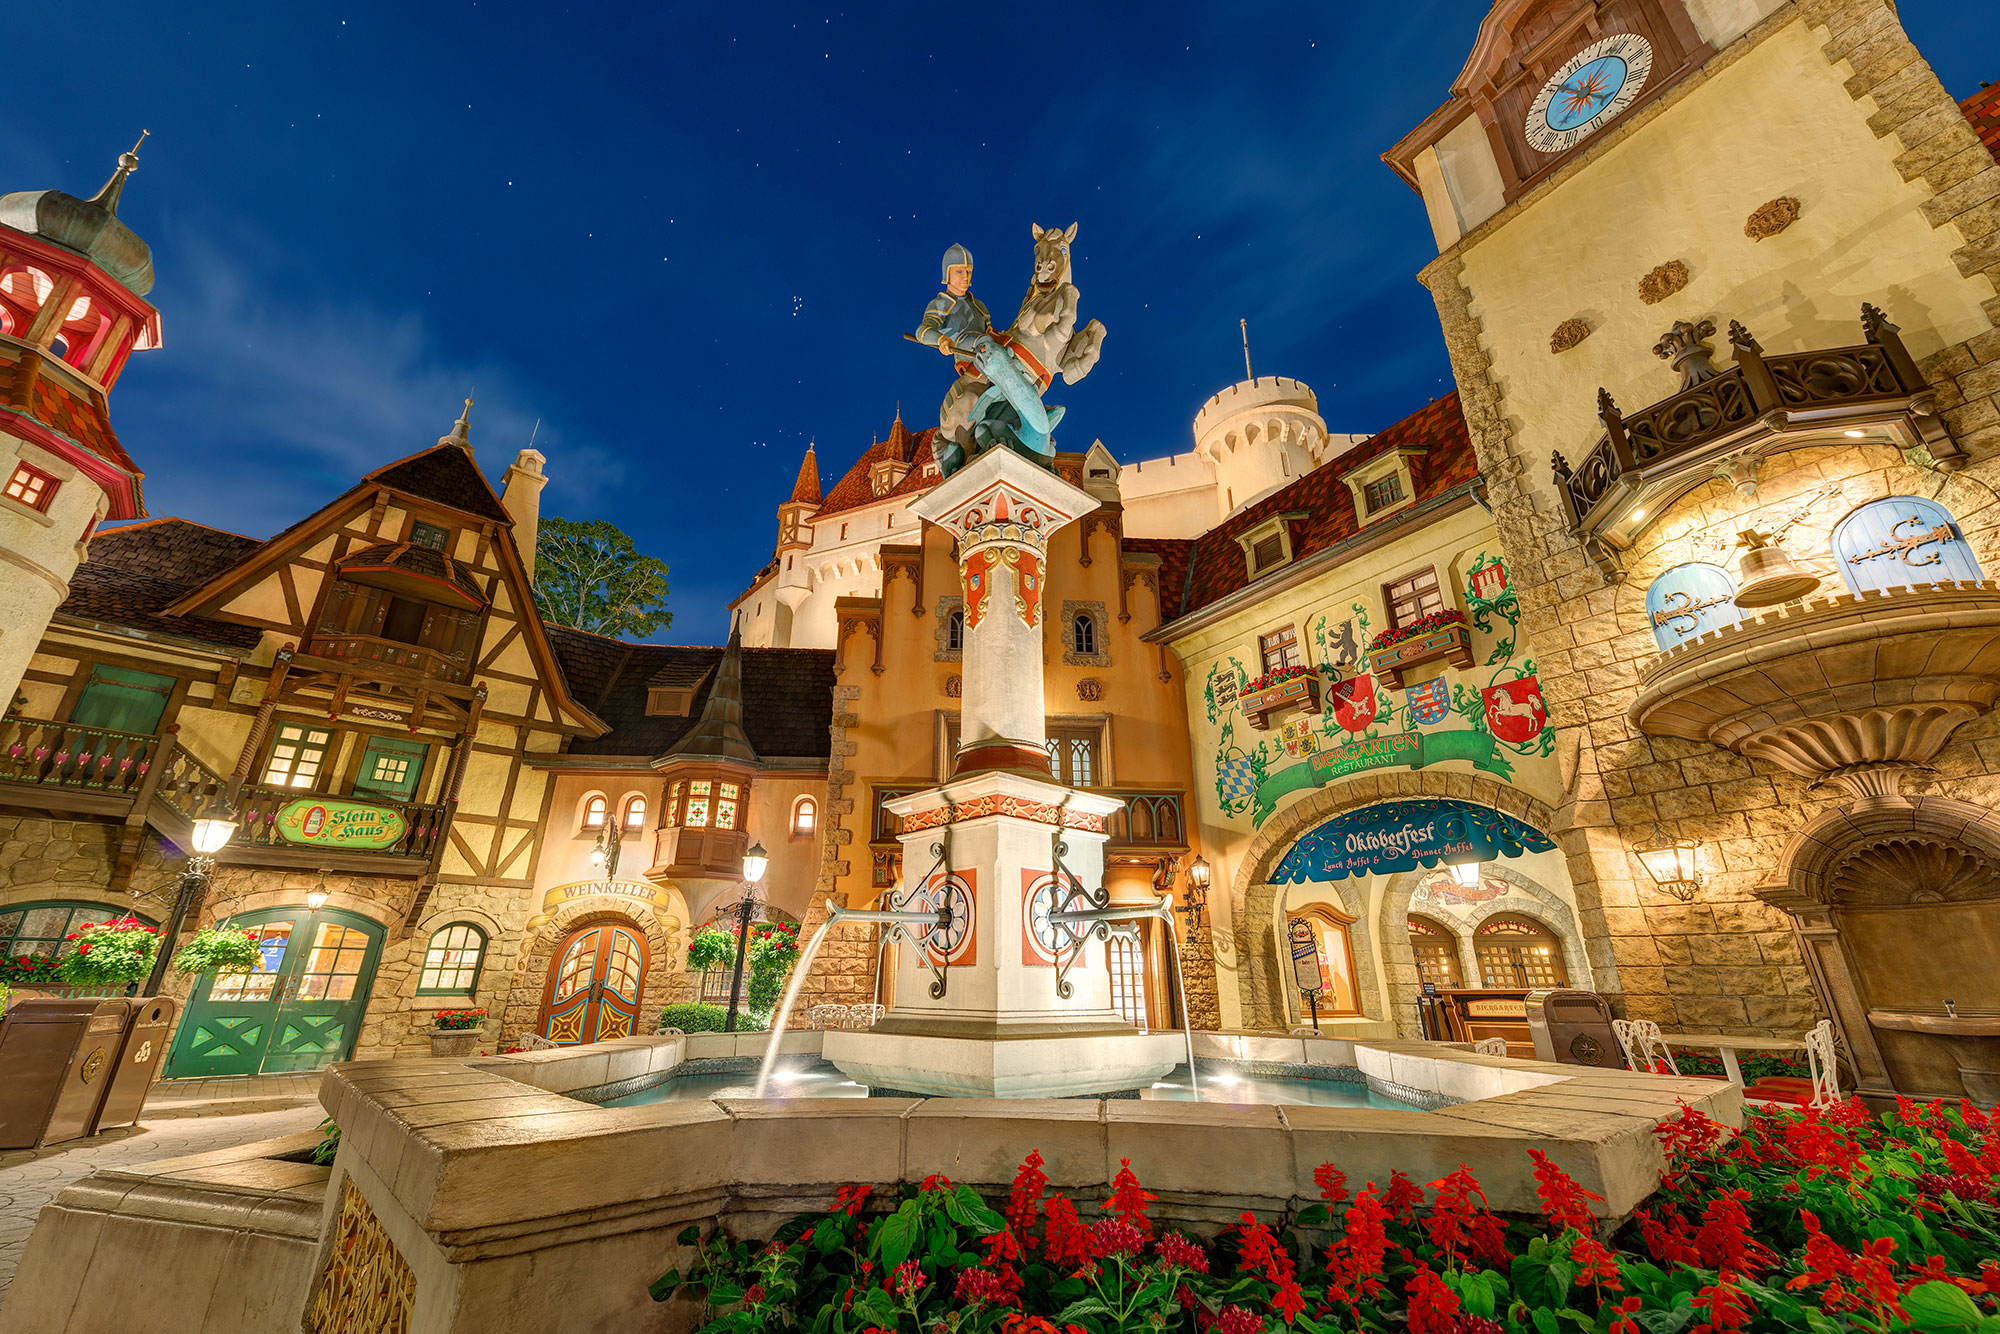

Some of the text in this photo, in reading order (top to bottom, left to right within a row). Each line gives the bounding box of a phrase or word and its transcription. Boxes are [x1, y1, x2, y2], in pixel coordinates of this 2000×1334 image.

[1311, 734, 1419, 771] BIERGARTEN
[1331, 753, 1396, 776] RESTAURANT
[331, 810, 376, 824] Stein
[338, 823, 384, 837] Haus
[1345, 821, 1435, 860] Oktoberfest
[1411, 841, 1474, 859] Dinner Buffet
[1322, 855, 1381, 872] Lunch Buffet &
[563, 882, 657, 901] WEINKELLER
